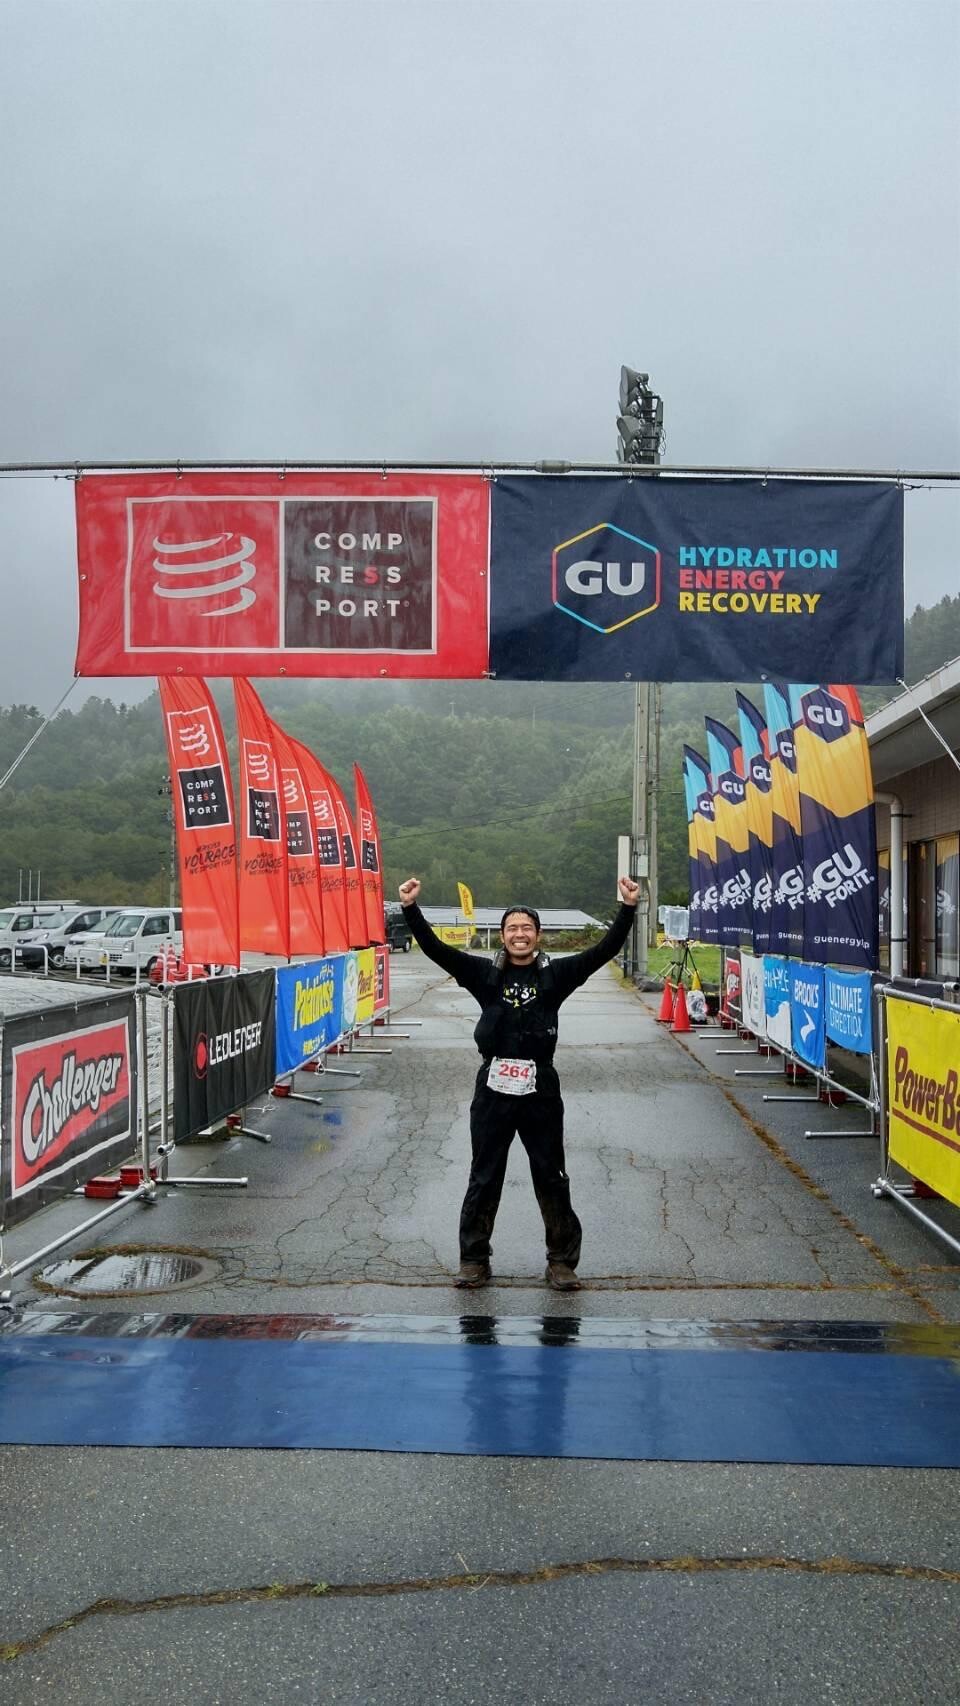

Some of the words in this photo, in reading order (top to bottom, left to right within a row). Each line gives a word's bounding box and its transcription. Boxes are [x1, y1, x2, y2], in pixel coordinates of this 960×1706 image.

[315, 532, 403, 551] COMP
[679, 546, 838, 569] HYDRATION
[315, 566, 402, 585] RESS
[565, 561, 645, 596] GU
[679, 569, 786, 590] ENERGY
[679, 592, 821, 614] RECOVERY
[807, 704, 844, 727] GU
[780, 741, 797, 758] G
[753, 765, 772, 782] GU
[186, 779, 214, 790] COMP
[721, 780, 744, 795] GU
[187, 791, 217, 803] RESS
[188, 804, 219, 816] PORT
[806, 843, 862, 904] #GU
[794, 979, 819, 1009] BROOKS
[829, 981, 863, 1014] ULTIMATE
[209, 1021, 262, 1066] LEDLENSER
[498, 1063, 530, 1080] 264
[22, 1053, 123, 1163] Challenger
